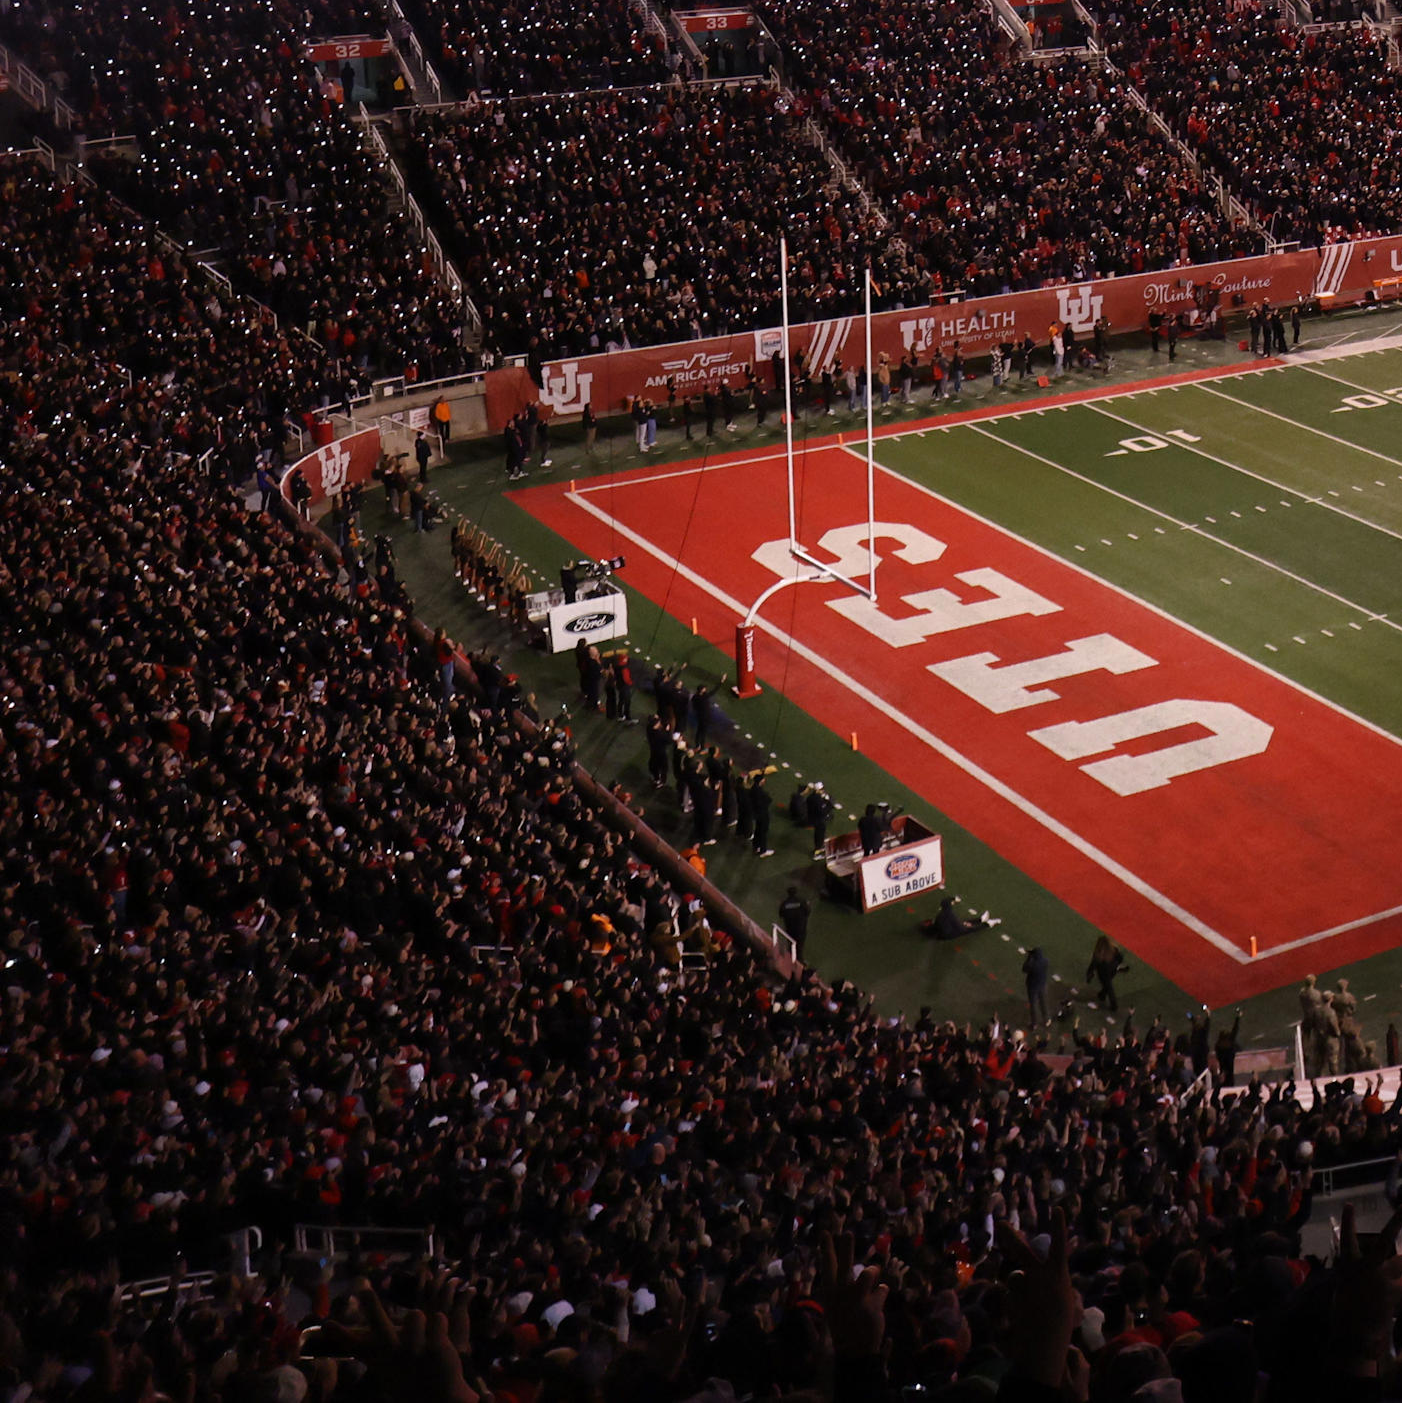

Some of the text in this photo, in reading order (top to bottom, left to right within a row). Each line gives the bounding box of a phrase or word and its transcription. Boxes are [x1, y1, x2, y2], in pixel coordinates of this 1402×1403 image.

[706, 16, 727, 29] 33
[335, 44, 360, 58] 32
[941, 310, 1016, 338] HEALTH
[644, 361, 748, 388] AMRICA FIRST
[573, 614, 607, 633] Ford
[871, 871, 937, 905] A SUB ABOVE
